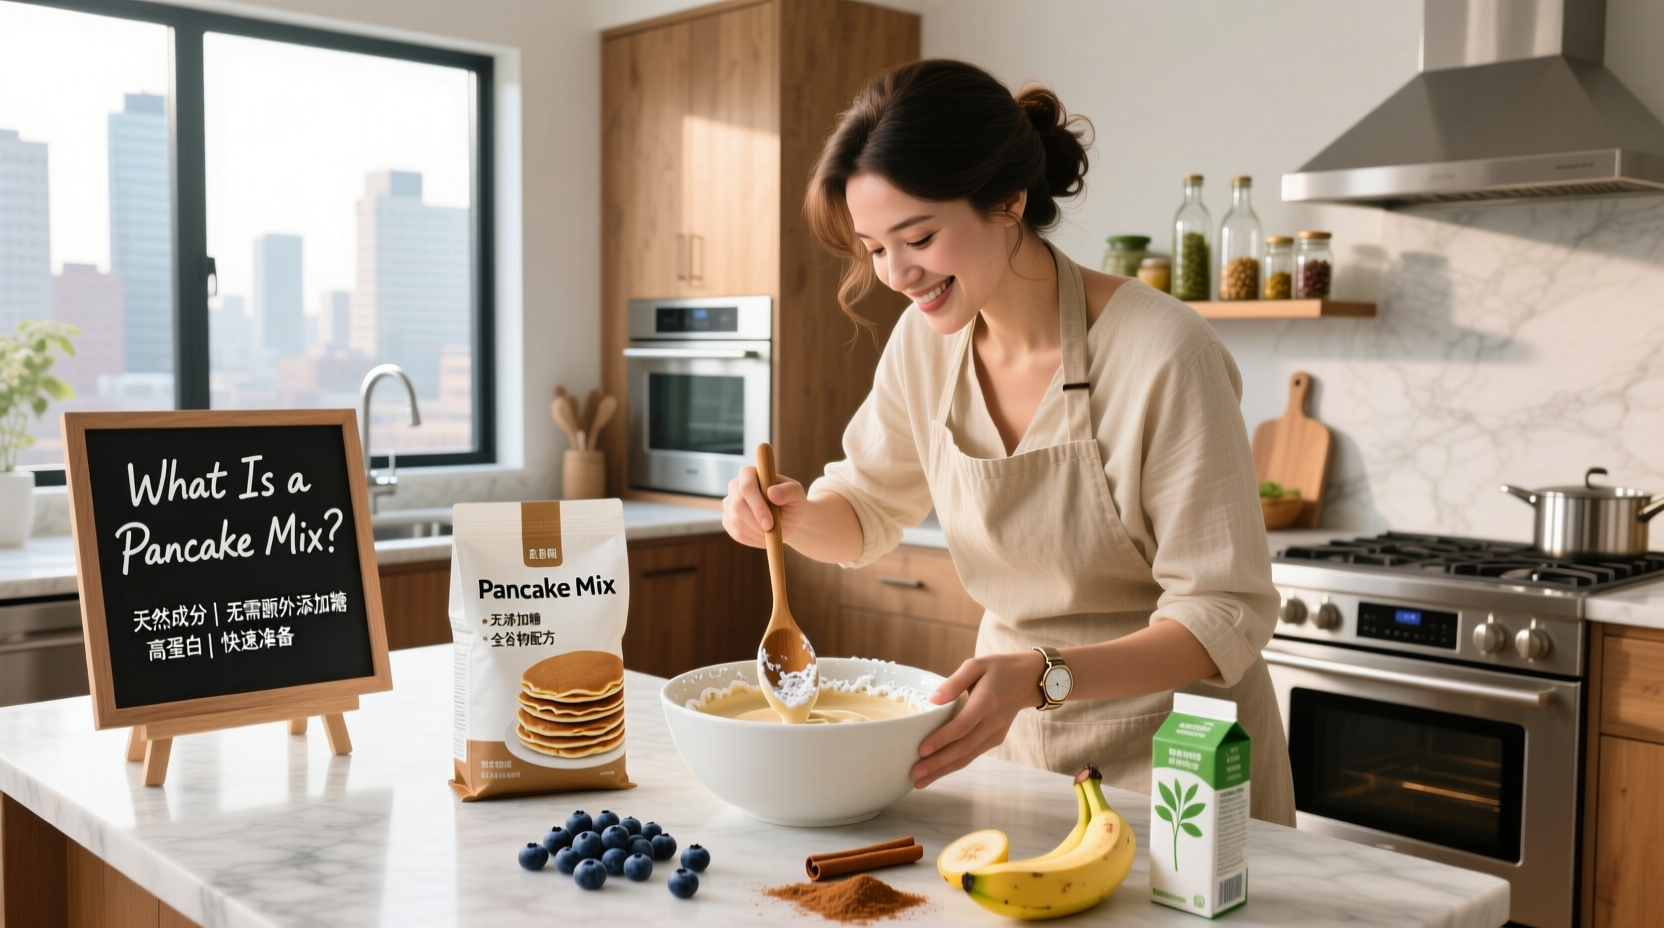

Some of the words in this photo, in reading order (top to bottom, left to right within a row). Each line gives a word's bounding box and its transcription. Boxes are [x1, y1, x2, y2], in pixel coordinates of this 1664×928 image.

[128, 459, 227, 507] What
[239, 455, 274, 499] Is
[288, 472, 311, 493] a
[115, 519, 254, 575] Pancake
[266, 508, 343, 555] Mix?
[479, 578, 570, 599] Pancake
[576, 575, 616, 596] Mix
